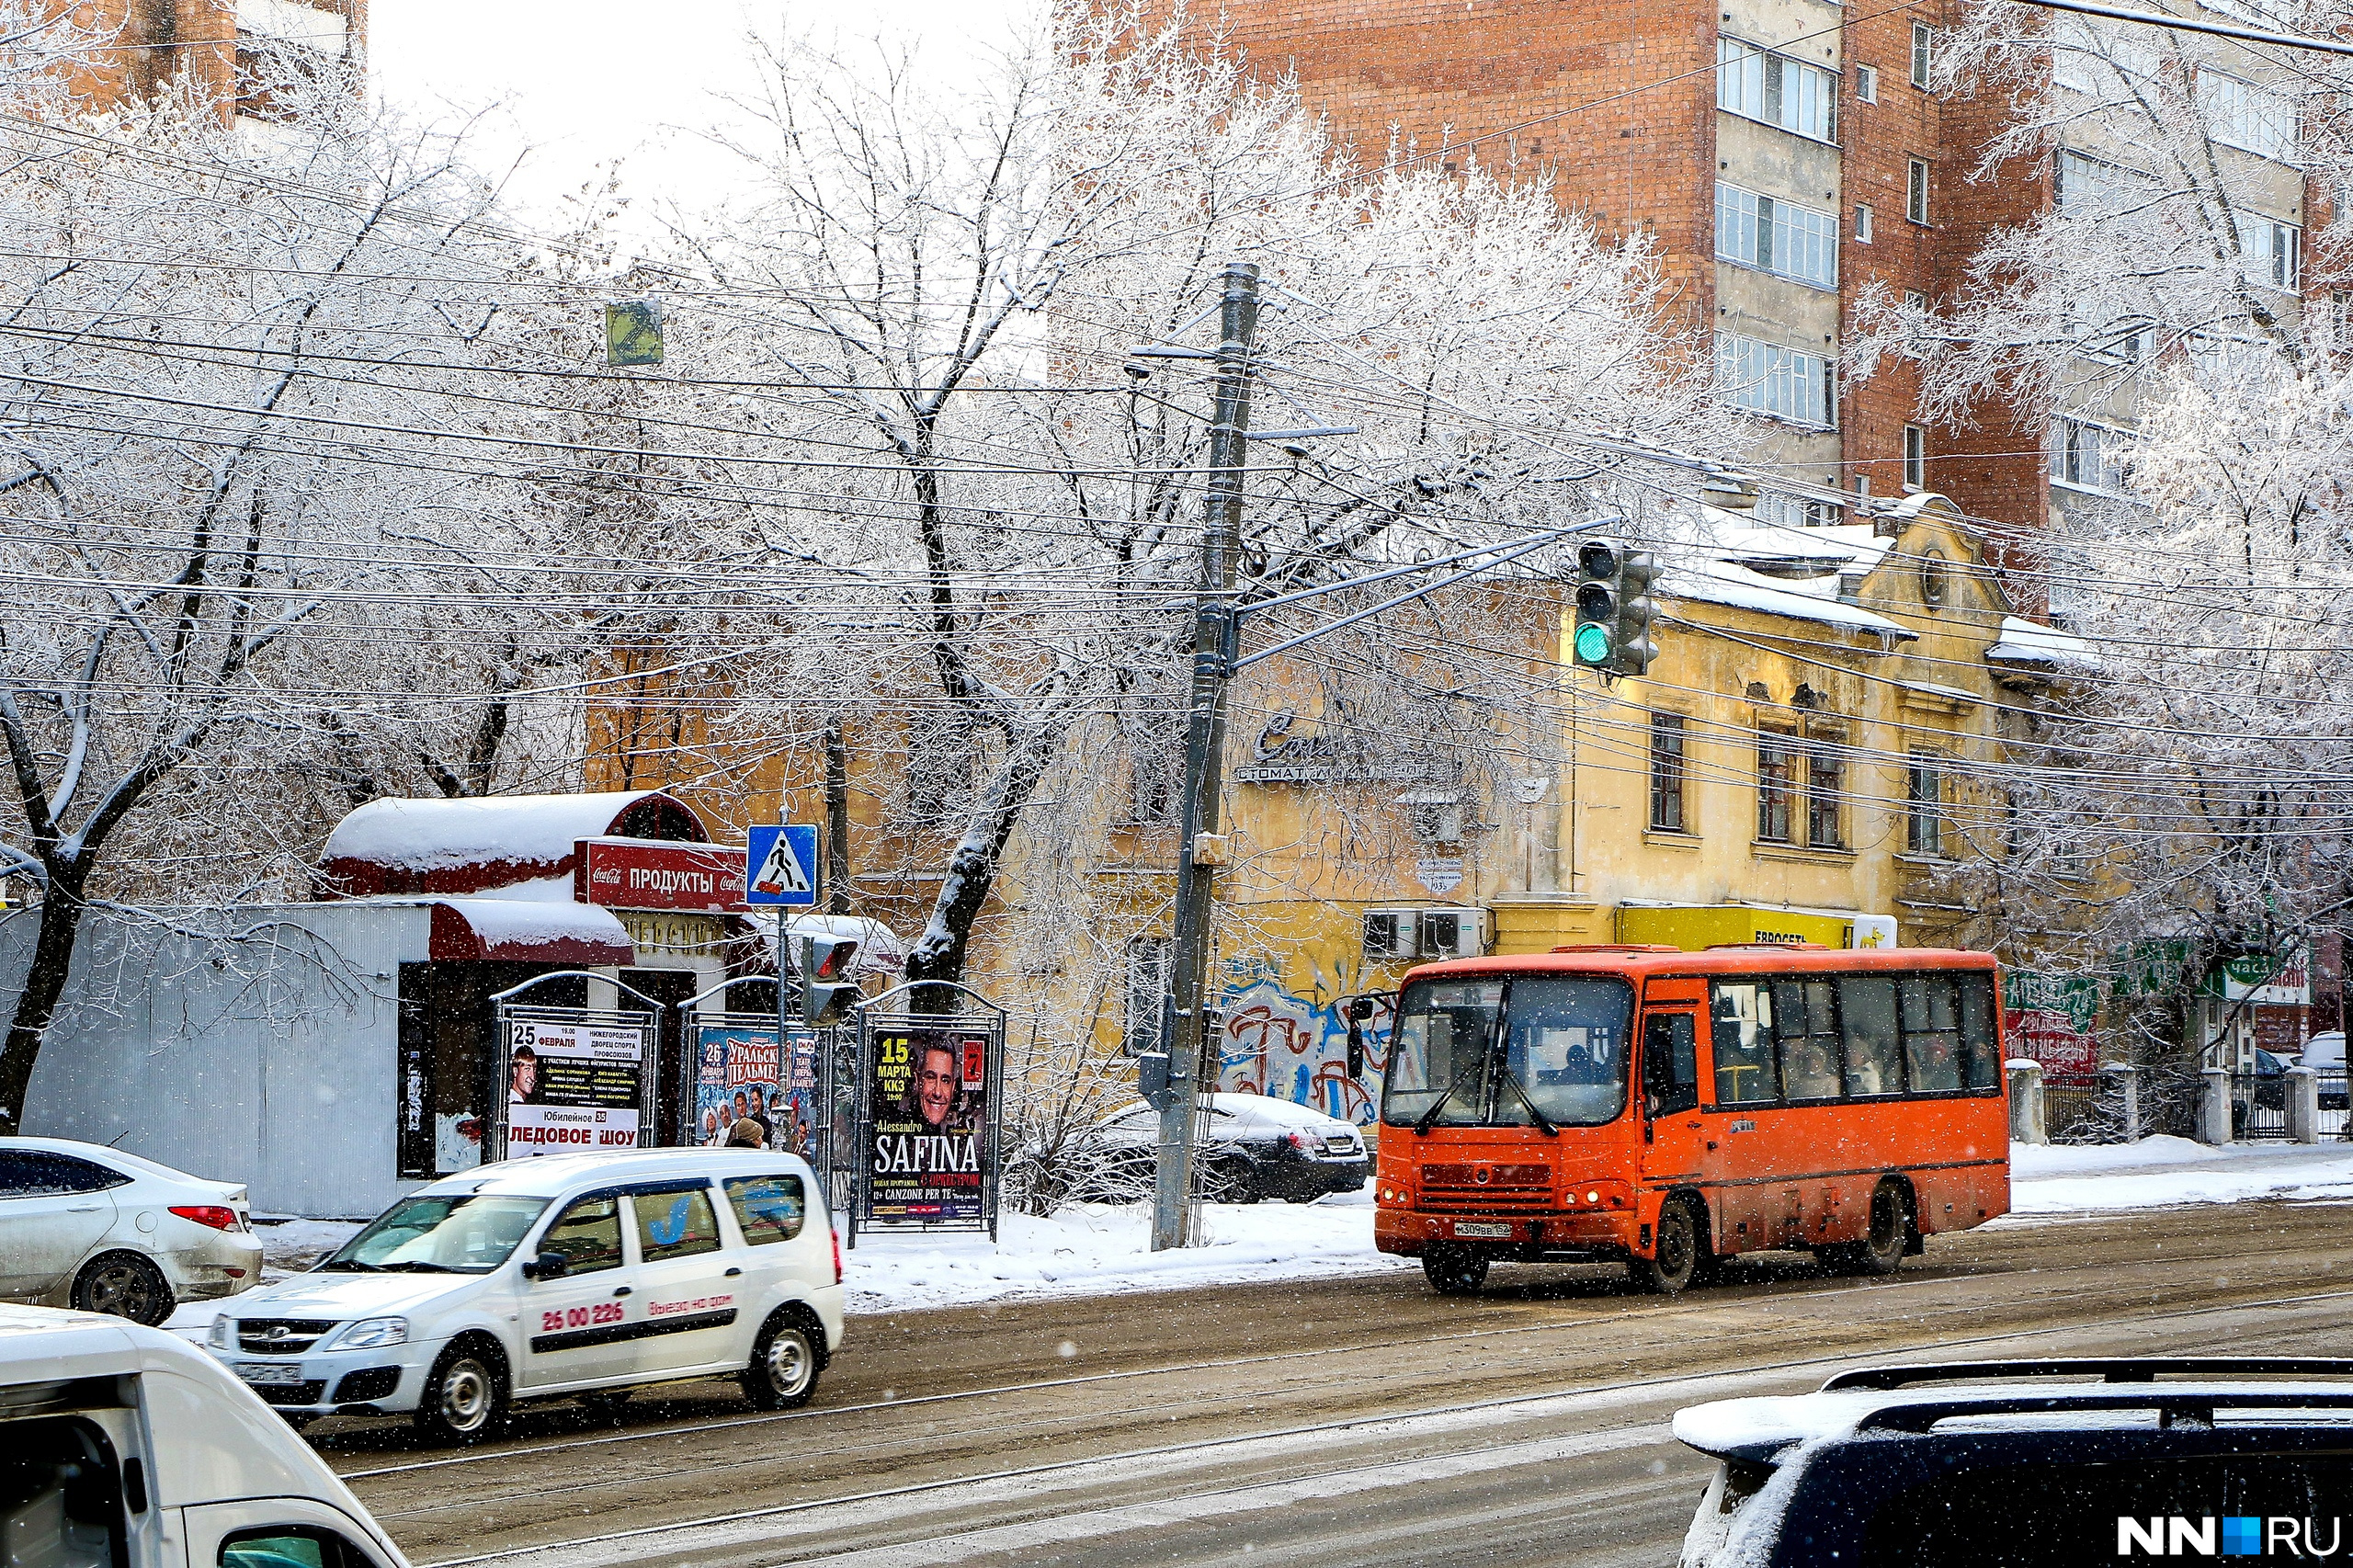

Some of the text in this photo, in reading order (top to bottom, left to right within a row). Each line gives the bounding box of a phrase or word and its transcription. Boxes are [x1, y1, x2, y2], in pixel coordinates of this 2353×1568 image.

[593, 867, 622, 884] Coca-Cola
[630, 868, 713, 893] ПРОДУКТЫ
[1756, 930, 1807, 943] ЕВРОСЕТЬ
[514, 1025, 536, 1045] 25
[589, 1029, 638, 1040] НИЖЕГОРОДСКИЙ
[539, 1037, 575, 1048] ФЕВРАЛЯ
[591, 1040, 636, 1050] ДВОРЕЦ СПОРТА
[594, 1050, 632, 1059] ПРОФСОЮЗОВ
[707, 1043, 722, 1062] 26
[882, 1038, 908, 1063] 15
[701, 1066, 724, 1076] ЯНВАРЯ
[878, 1065, 912, 1078] МАРТА
[884, 1080, 905, 1092] ККЗ
[887, 1093, 903, 1101] 19:00
[543, 1110, 607, 1122] Юбилейное 35
[877, 1119, 922, 1134] Alessandro
[510, 1126, 636, 1145] ЛЕДОВОЕ ШОУ
[875, 1135, 979, 1173] SAFINA
[920, 1174, 980, 1187] С ОРКЕСТРОМ
[873, 1191, 883, 1199] 12+
[885, 1188, 923, 1200] CANZONE
[925, 1188, 939, 1199] PER
[942, 1188, 951, 1199] TE
[541, 1301, 623, 1332] 26 00 226
